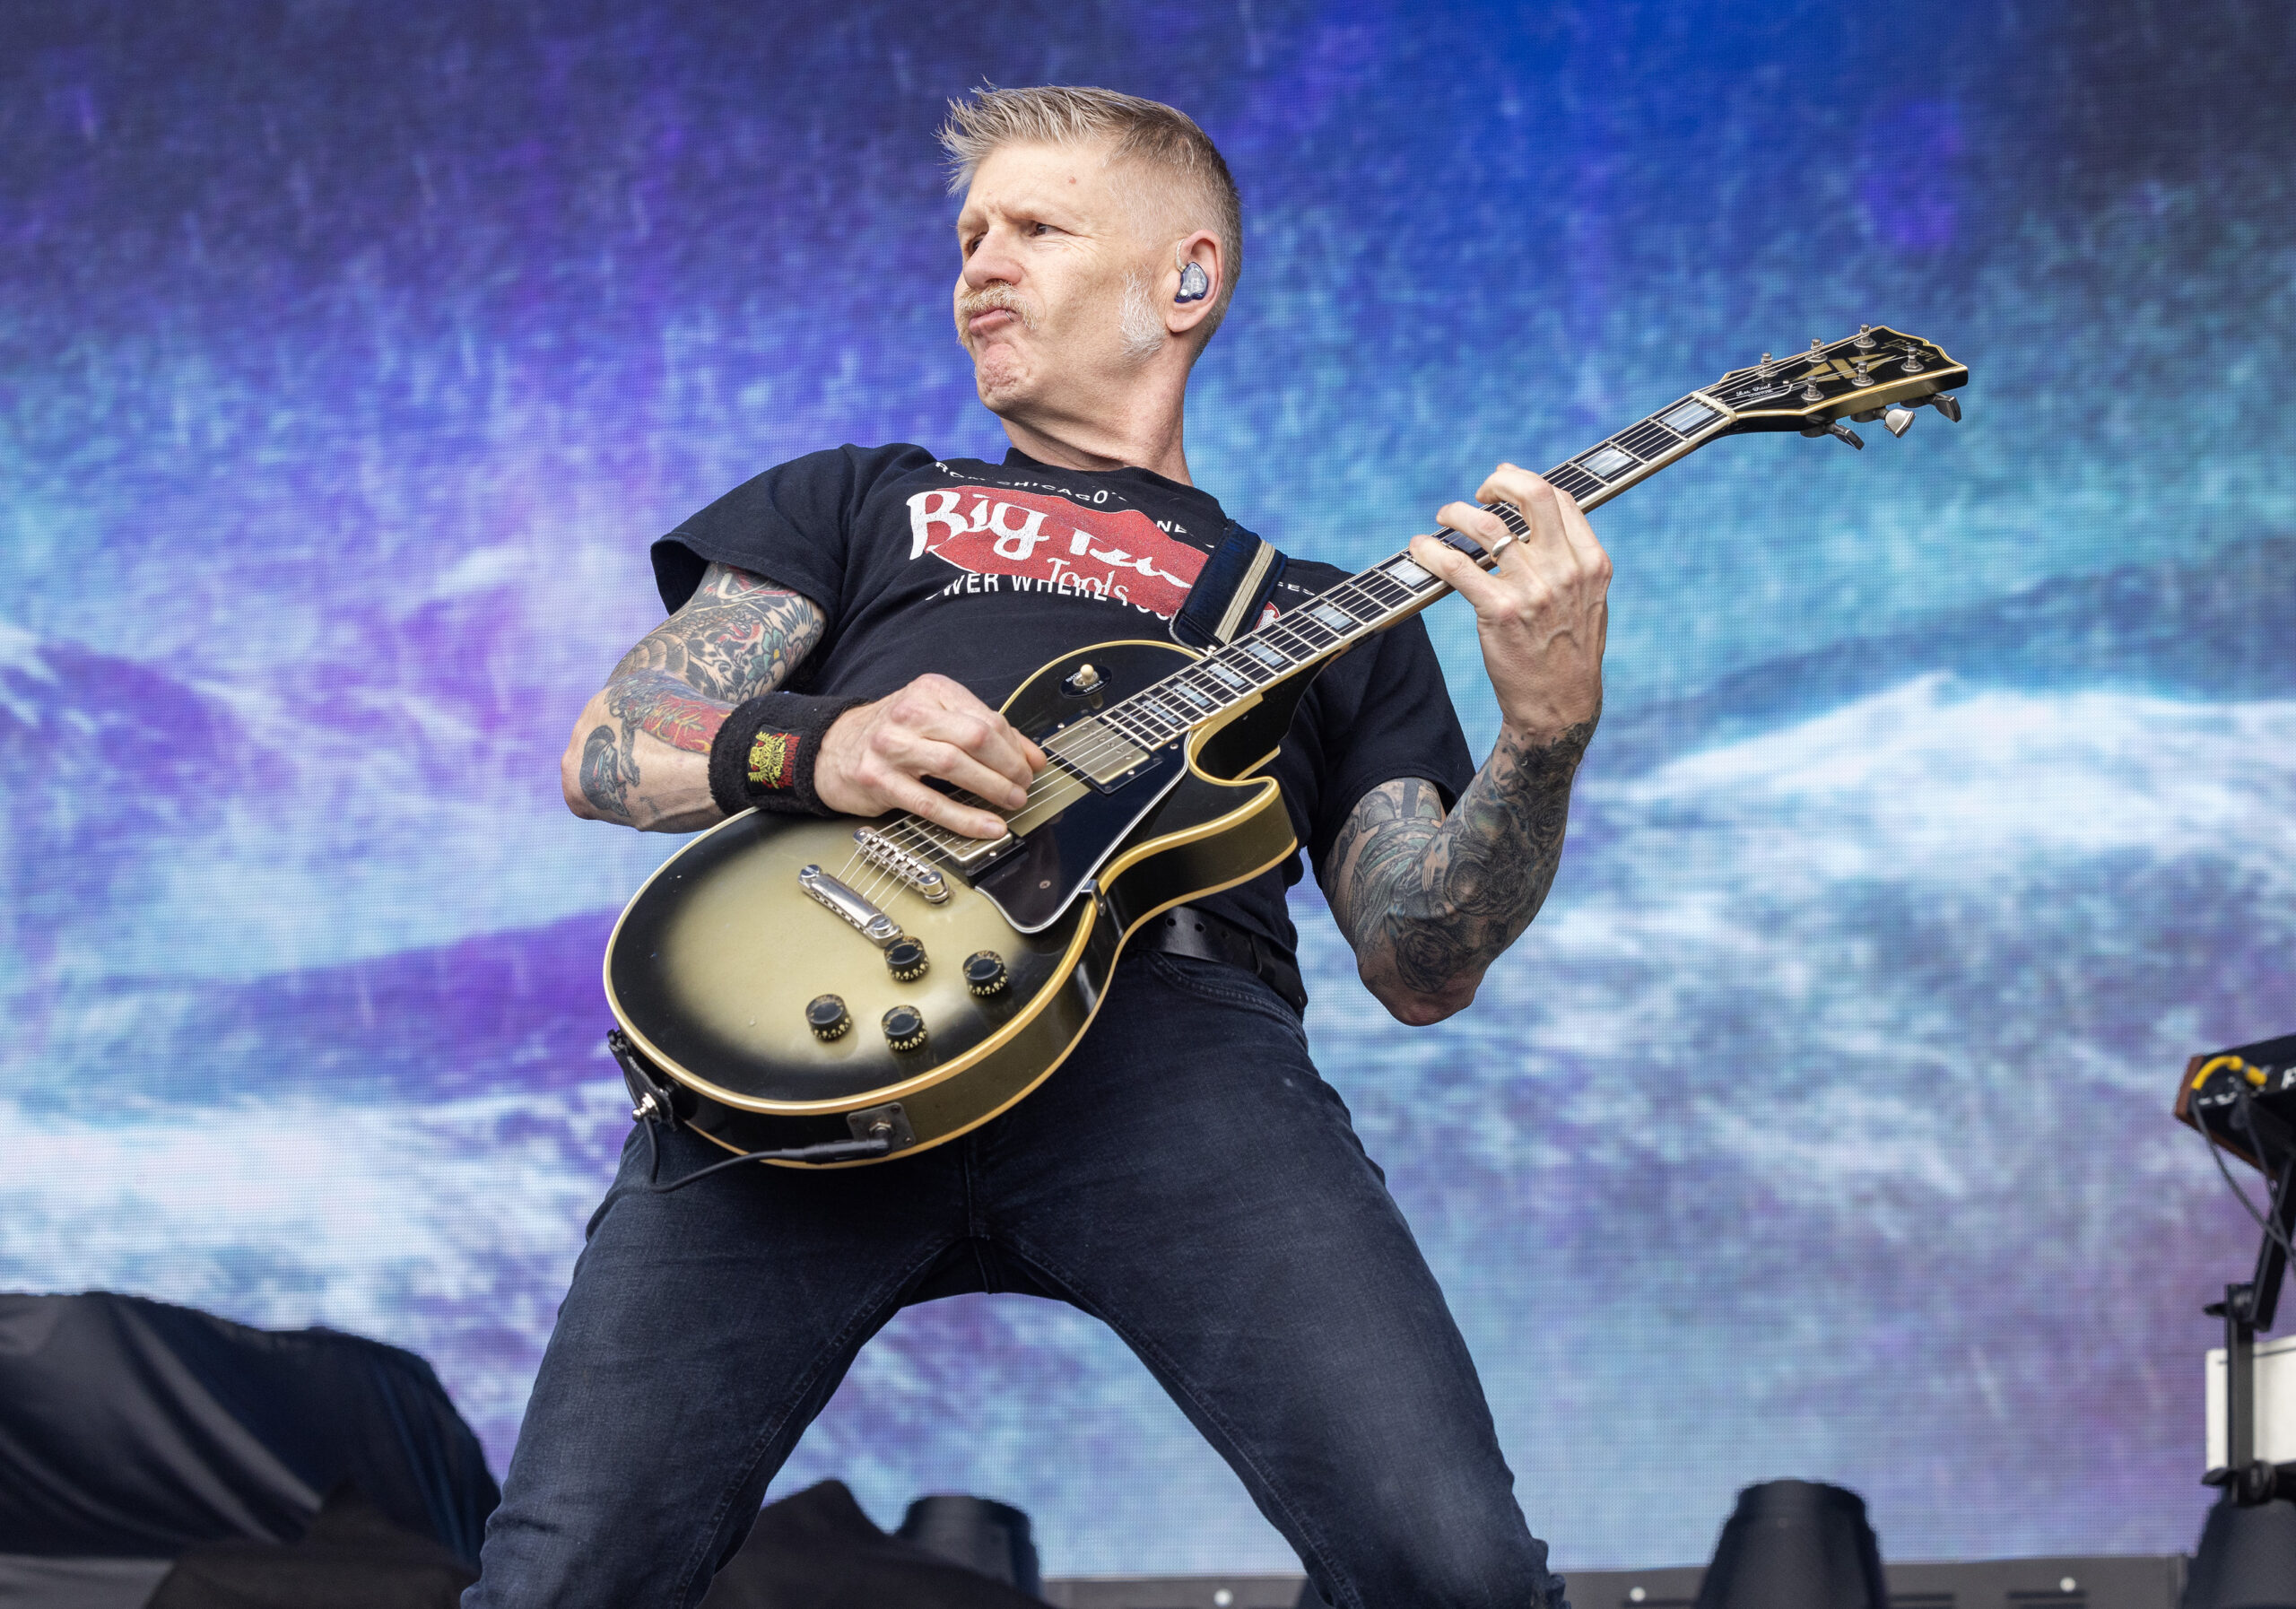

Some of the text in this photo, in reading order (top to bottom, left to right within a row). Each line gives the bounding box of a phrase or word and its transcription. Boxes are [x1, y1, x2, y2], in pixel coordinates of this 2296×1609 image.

[1880, 338, 1938, 362] Gison
[906, 490, 1050, 561] Big
[1047, 557, 1129, 603] Tools
